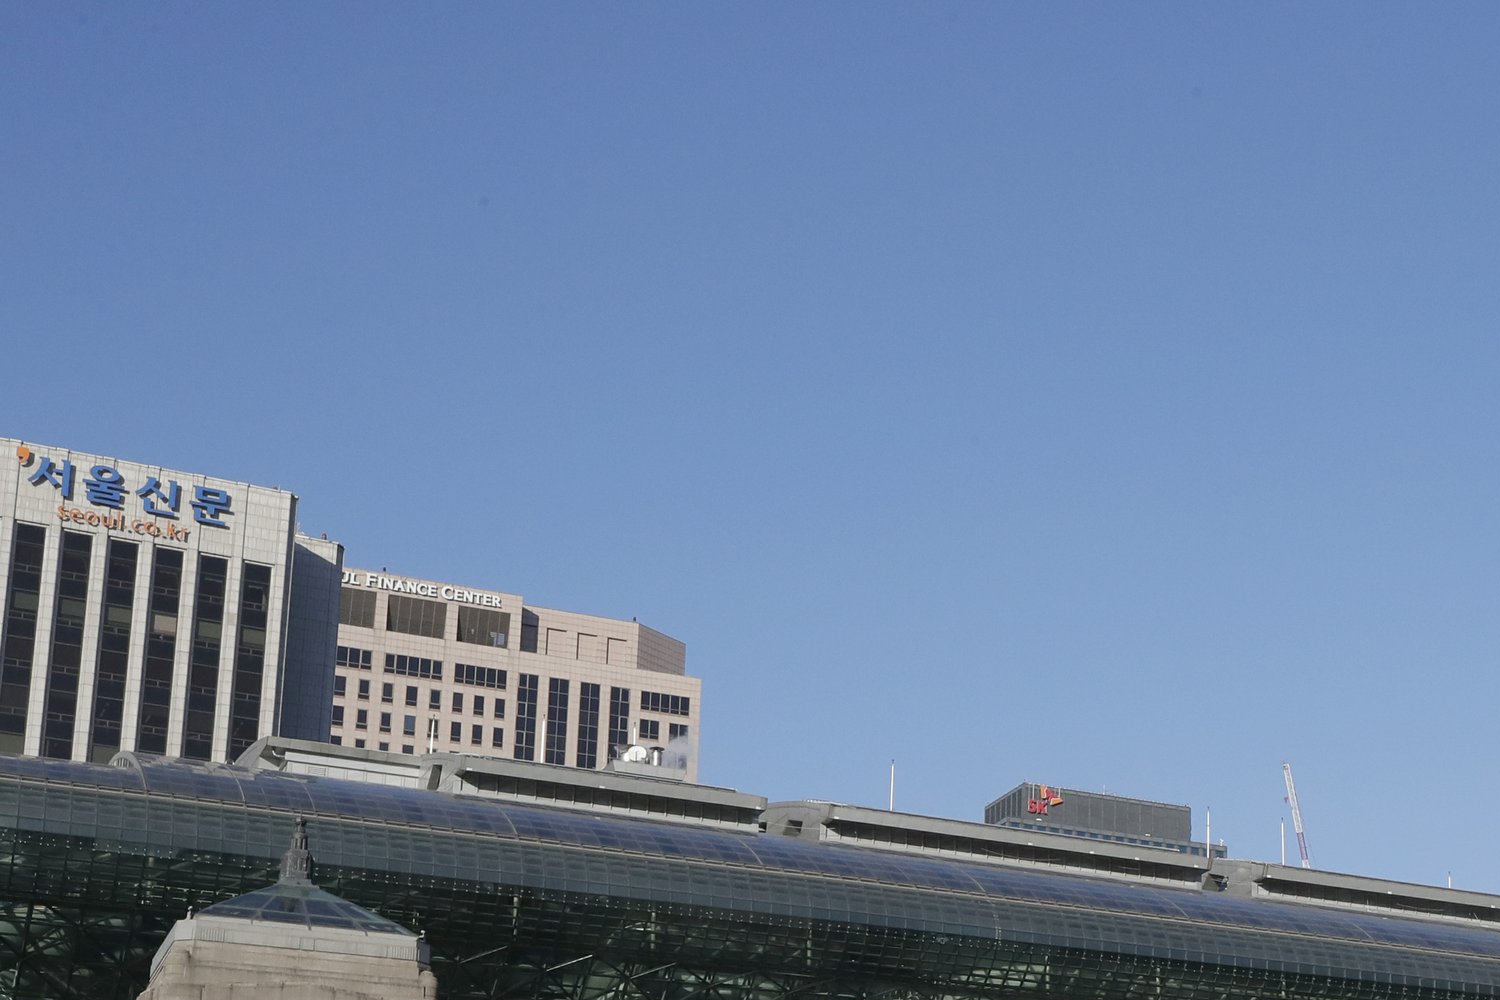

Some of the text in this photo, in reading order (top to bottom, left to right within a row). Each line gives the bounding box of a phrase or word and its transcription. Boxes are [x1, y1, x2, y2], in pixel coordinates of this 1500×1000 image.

[28, 456, 232, 527] 서울신문
[57, 506, 190, 541] seoul.co.kr
[366, 572, 437, 597] FINANCE
[441, 585, 502, 608] CENTER
[1028, 799, 1048, 814] SK
